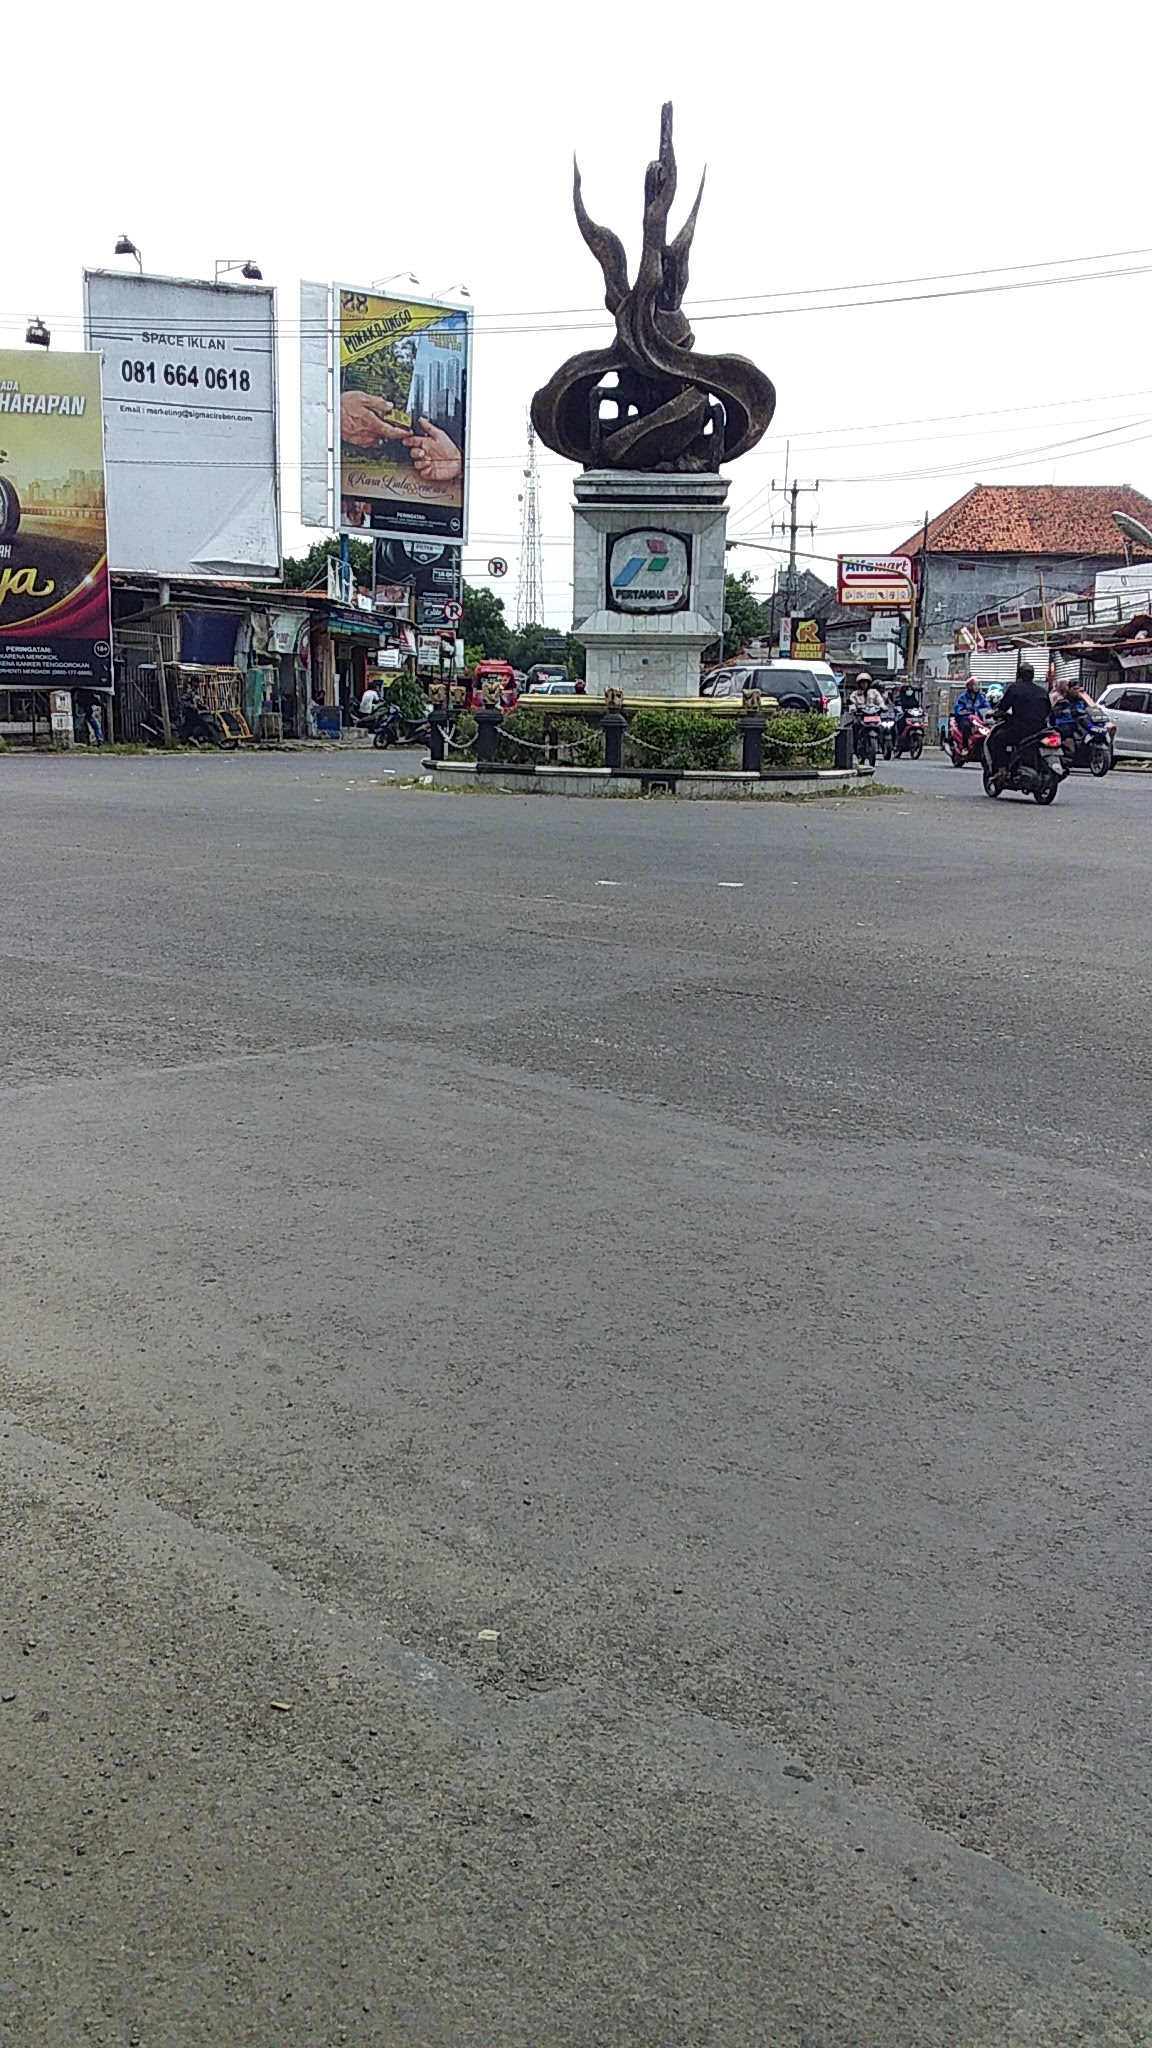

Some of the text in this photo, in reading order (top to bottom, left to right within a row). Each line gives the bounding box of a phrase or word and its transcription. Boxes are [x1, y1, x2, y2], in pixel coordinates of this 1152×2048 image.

[141, 332, 225, 350] SPACE IKLAN
[121, 360, 250, 391] 081 664 0618
[0, 381, 19, 390] ADA
[0, 393, 85, 415] HARAPAN
[119, 405, 140, 413] Email
[845, 559, 908, 573] Alfamart
[615, 589, 679, 600] PERTAMINA EP
